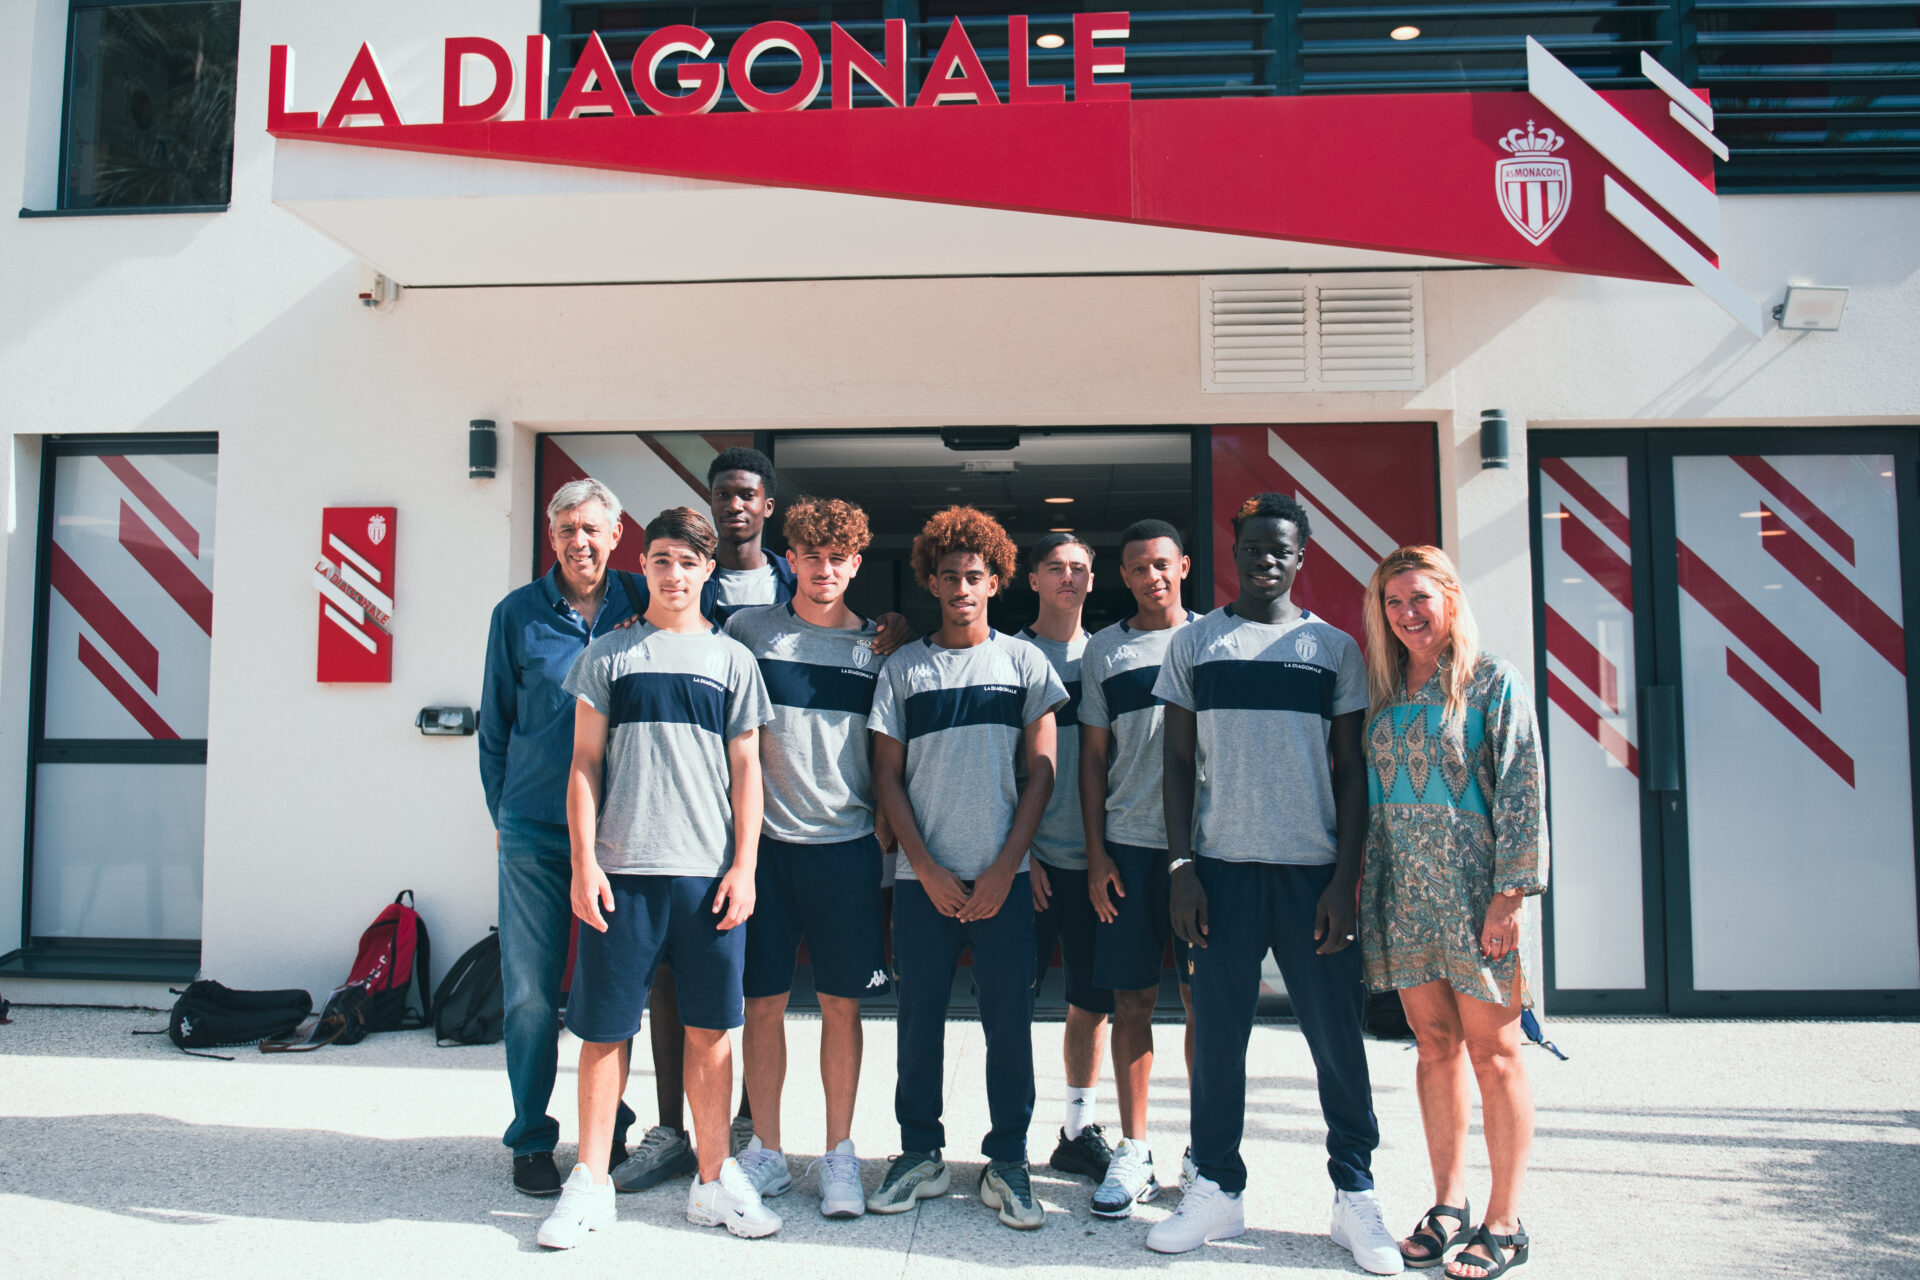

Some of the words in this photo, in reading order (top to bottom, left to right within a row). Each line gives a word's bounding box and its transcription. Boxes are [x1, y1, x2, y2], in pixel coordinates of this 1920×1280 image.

[267, 41, 403, 130] LA
[442, 11, 1131, 124] DIAGONALE
[1515, 167, 1553, 178] MONACO
[314, 561, 328, 578] LA
[329, 573, 390, 625] DIAGONALE
